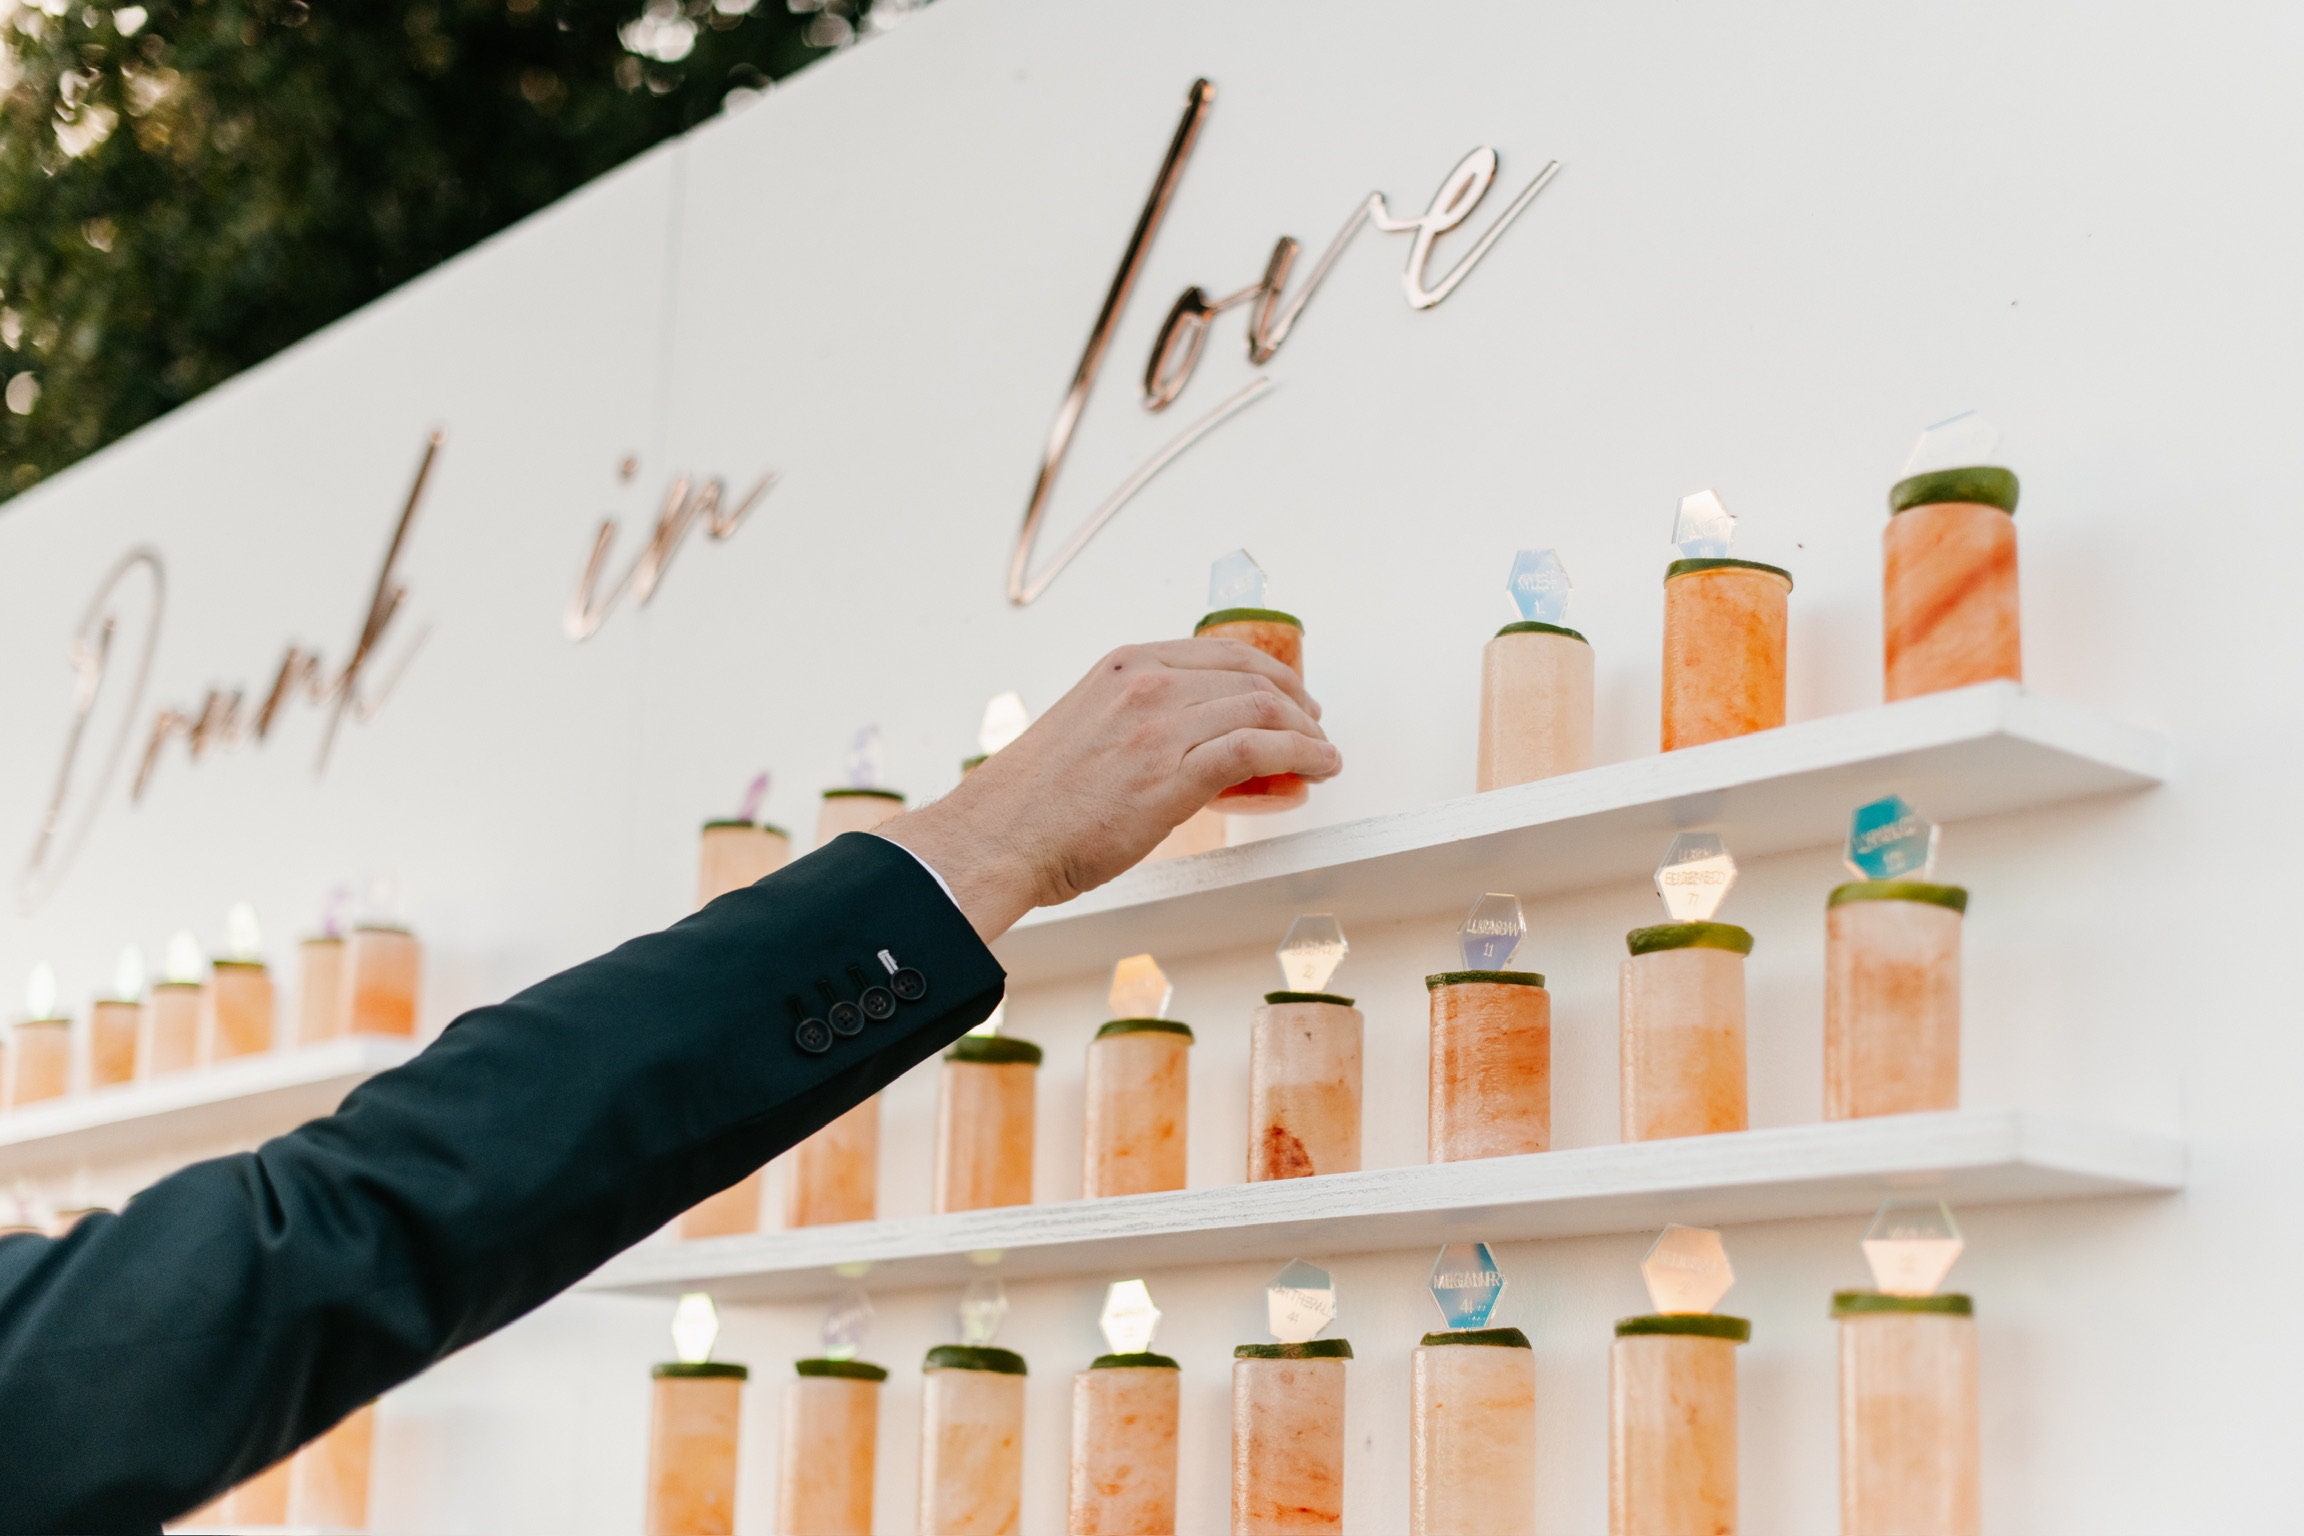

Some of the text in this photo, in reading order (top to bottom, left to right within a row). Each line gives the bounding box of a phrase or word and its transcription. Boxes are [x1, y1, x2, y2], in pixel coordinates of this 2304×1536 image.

[16, 76, 1562, 914] Drunk in Love
